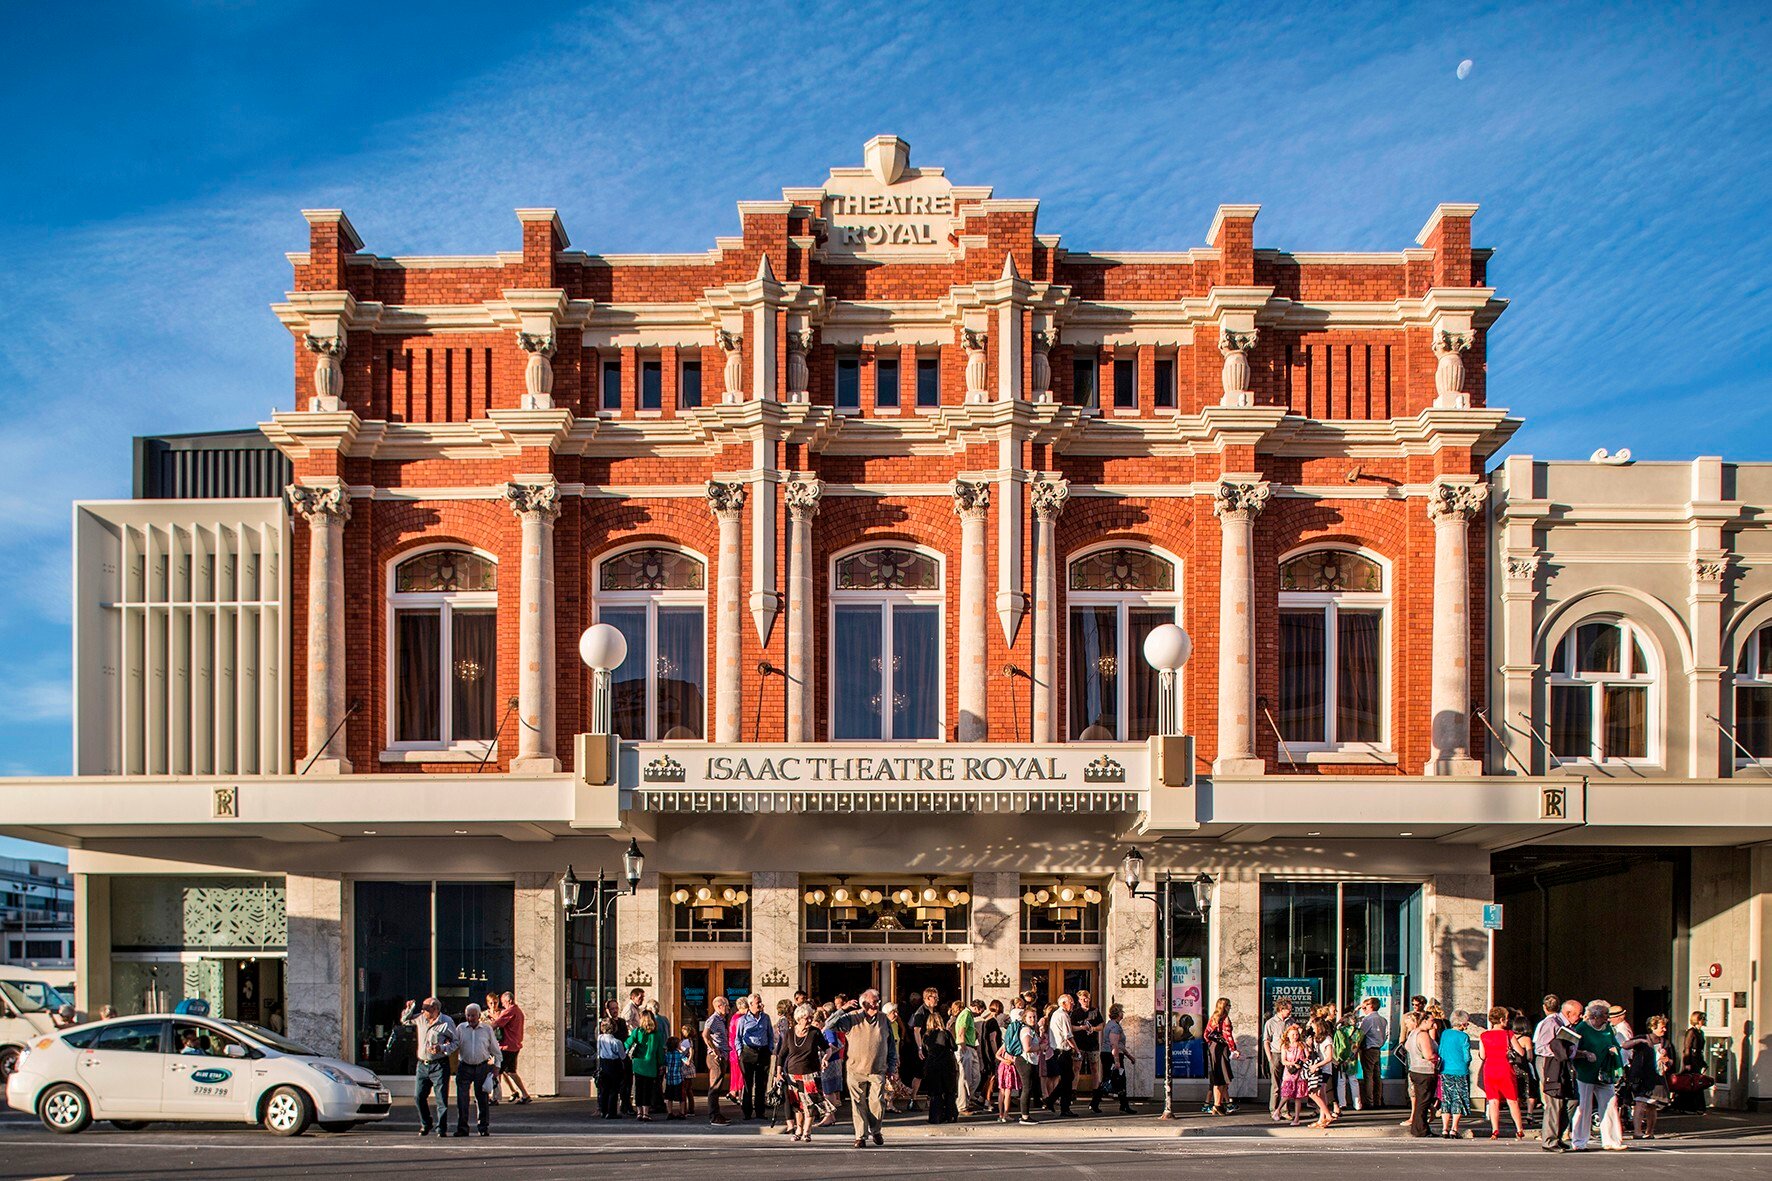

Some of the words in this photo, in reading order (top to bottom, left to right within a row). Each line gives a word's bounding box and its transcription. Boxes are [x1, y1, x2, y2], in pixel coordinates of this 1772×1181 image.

[829, 194, 951, 215] THEATRE
[843, 223, 937, 245] ROYAL
[702, 757, 801, 781] ISAAC
[805, 757, 955, 781] THEATRE
[961, 757, 1067, 781] ROYAL
[1489, 905, 1496, 914] P
[1276, 986, 1312, 995] ROYAL
[194, 1086, 213, 1094] 3799
[214, 1087, 229, 1096] 799
